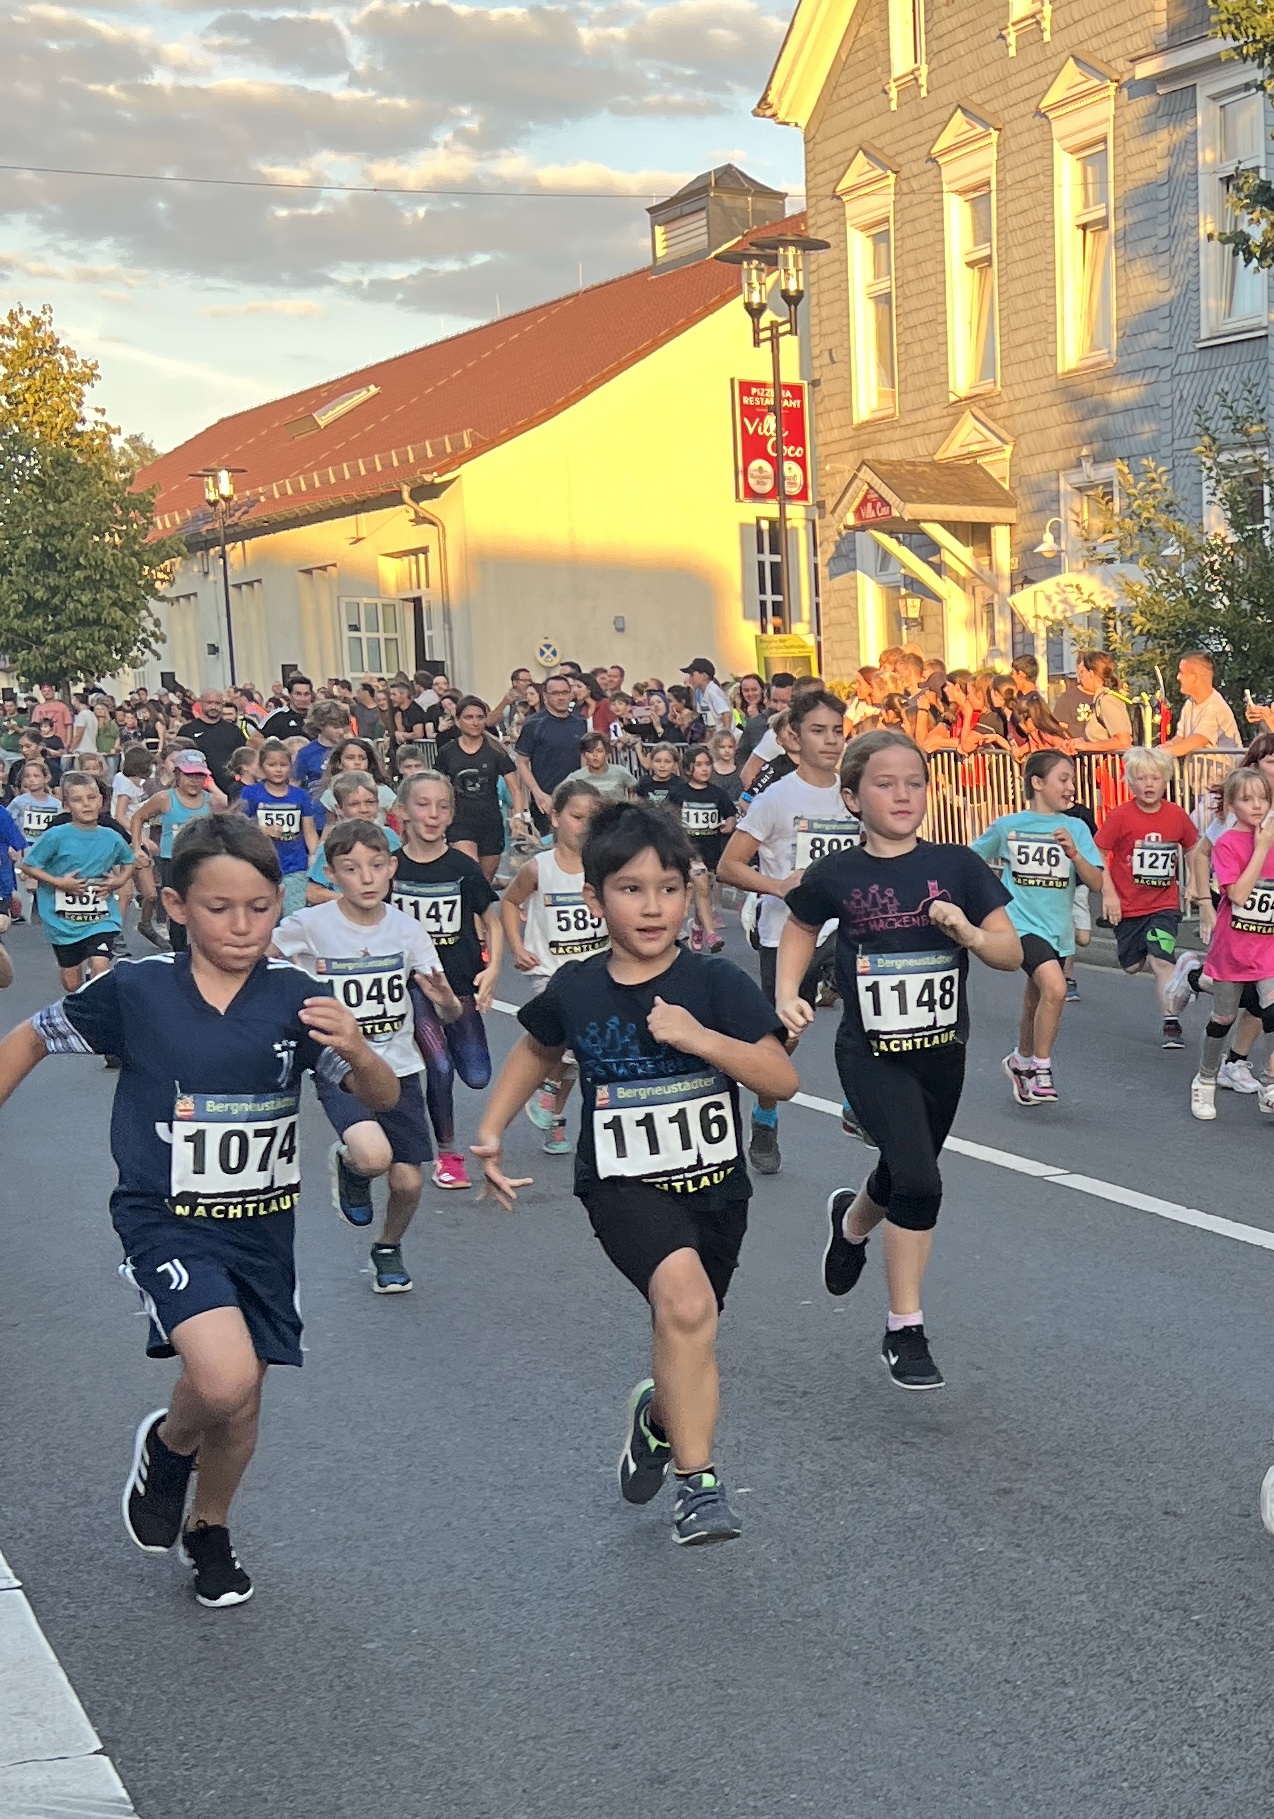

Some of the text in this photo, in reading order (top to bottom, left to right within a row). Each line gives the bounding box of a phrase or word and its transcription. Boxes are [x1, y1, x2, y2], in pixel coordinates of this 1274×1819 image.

[743, 396, 801, 409] RESTAANT
[751, 387, 792, 398] PIZZIA
[26, 813, 57, 826] 114
[264, 812, 296, 827] 550
[684, 810, 718, 824] 1130
[1016, 844, 1061, 867] 546
[394, 897, 458, 923] 1147
[1242, 891, 1274, 913] 56
[329, 973, 404, 1008] 046
[865, 975, 955, 1017] 1148
[603, 1100, 729, 1159] 1116
[184, 1120, 297, 1175] 1074
